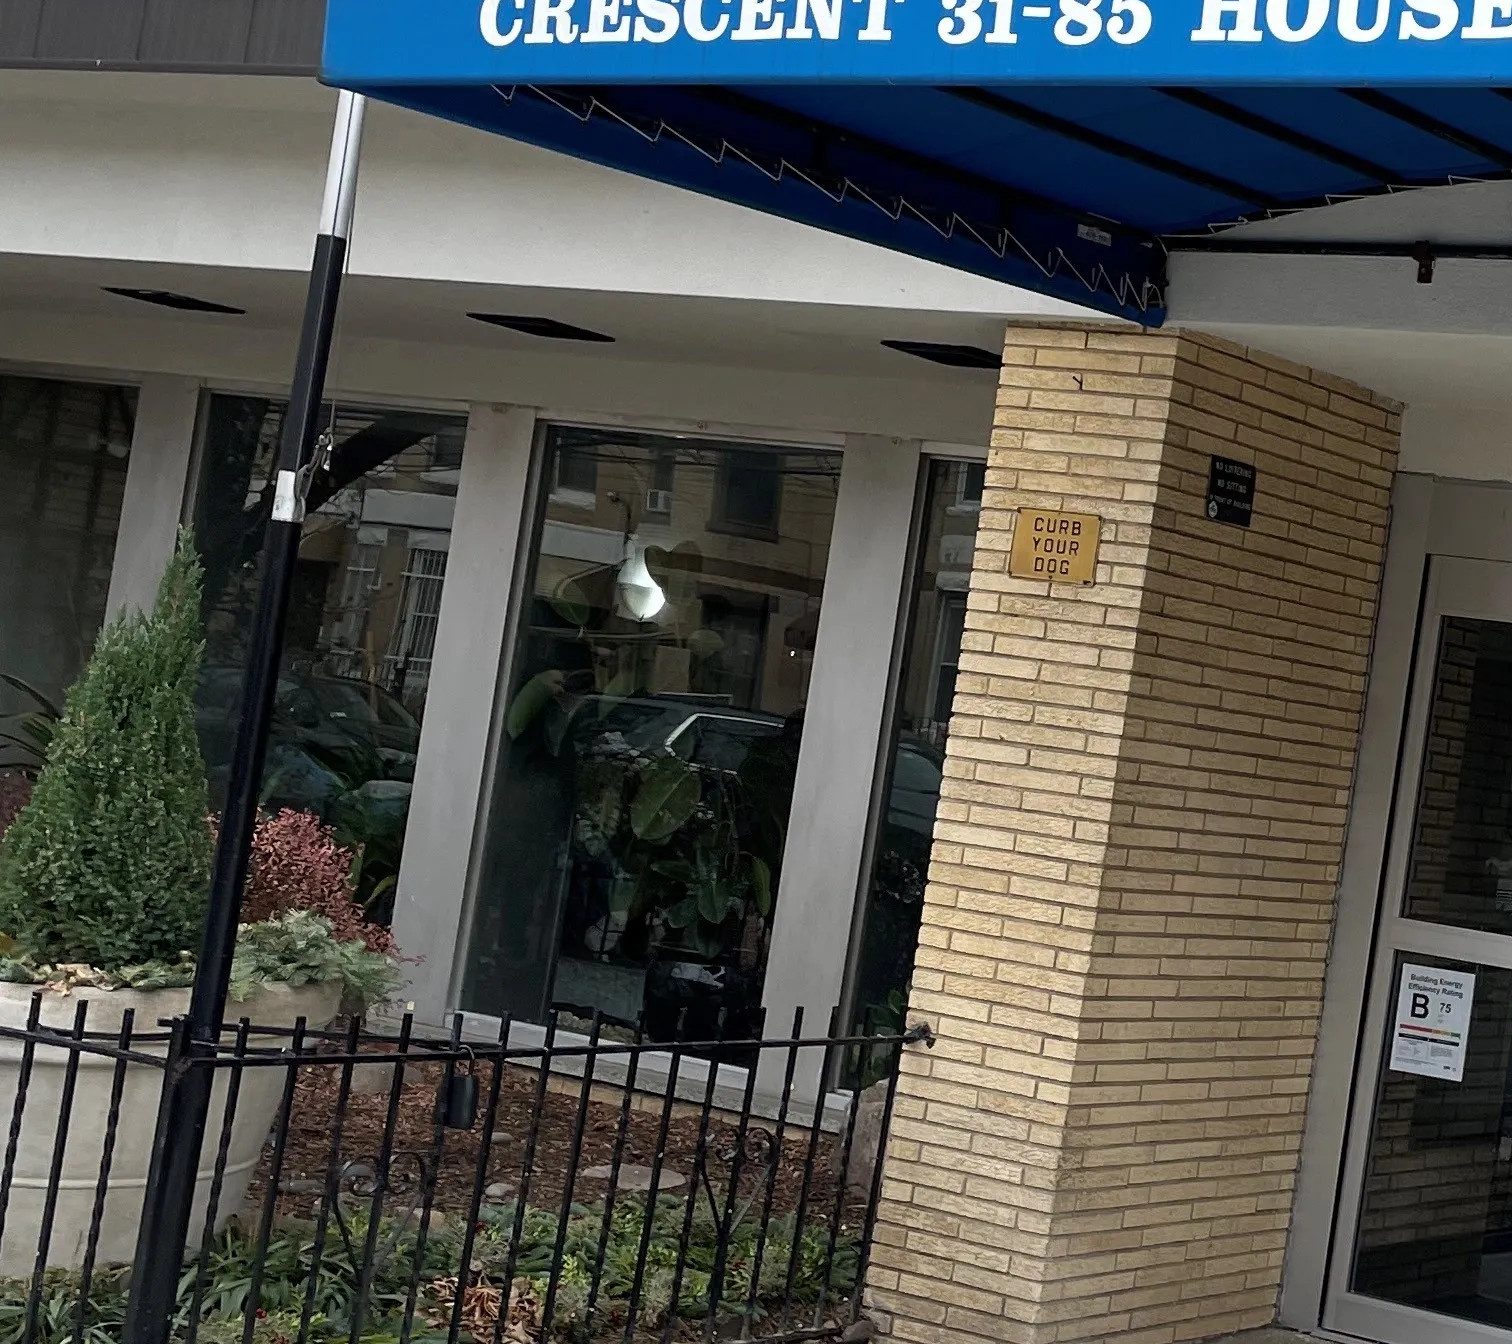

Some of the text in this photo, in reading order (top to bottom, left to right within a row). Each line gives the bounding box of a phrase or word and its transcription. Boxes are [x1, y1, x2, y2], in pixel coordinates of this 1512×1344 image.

[1034, 517, 1081, 536] CURB
[1032, 536, 1080, 556] YOUR
[1033, 556, 1070, 575] DOG
[1408, 982, 1464, 999] Efficiency Rating
[1411, 973, 1463, 989] Building Energy
[1411, 992, 1430, 1018] B
[1440, 1002, 1452, 1013] 75
